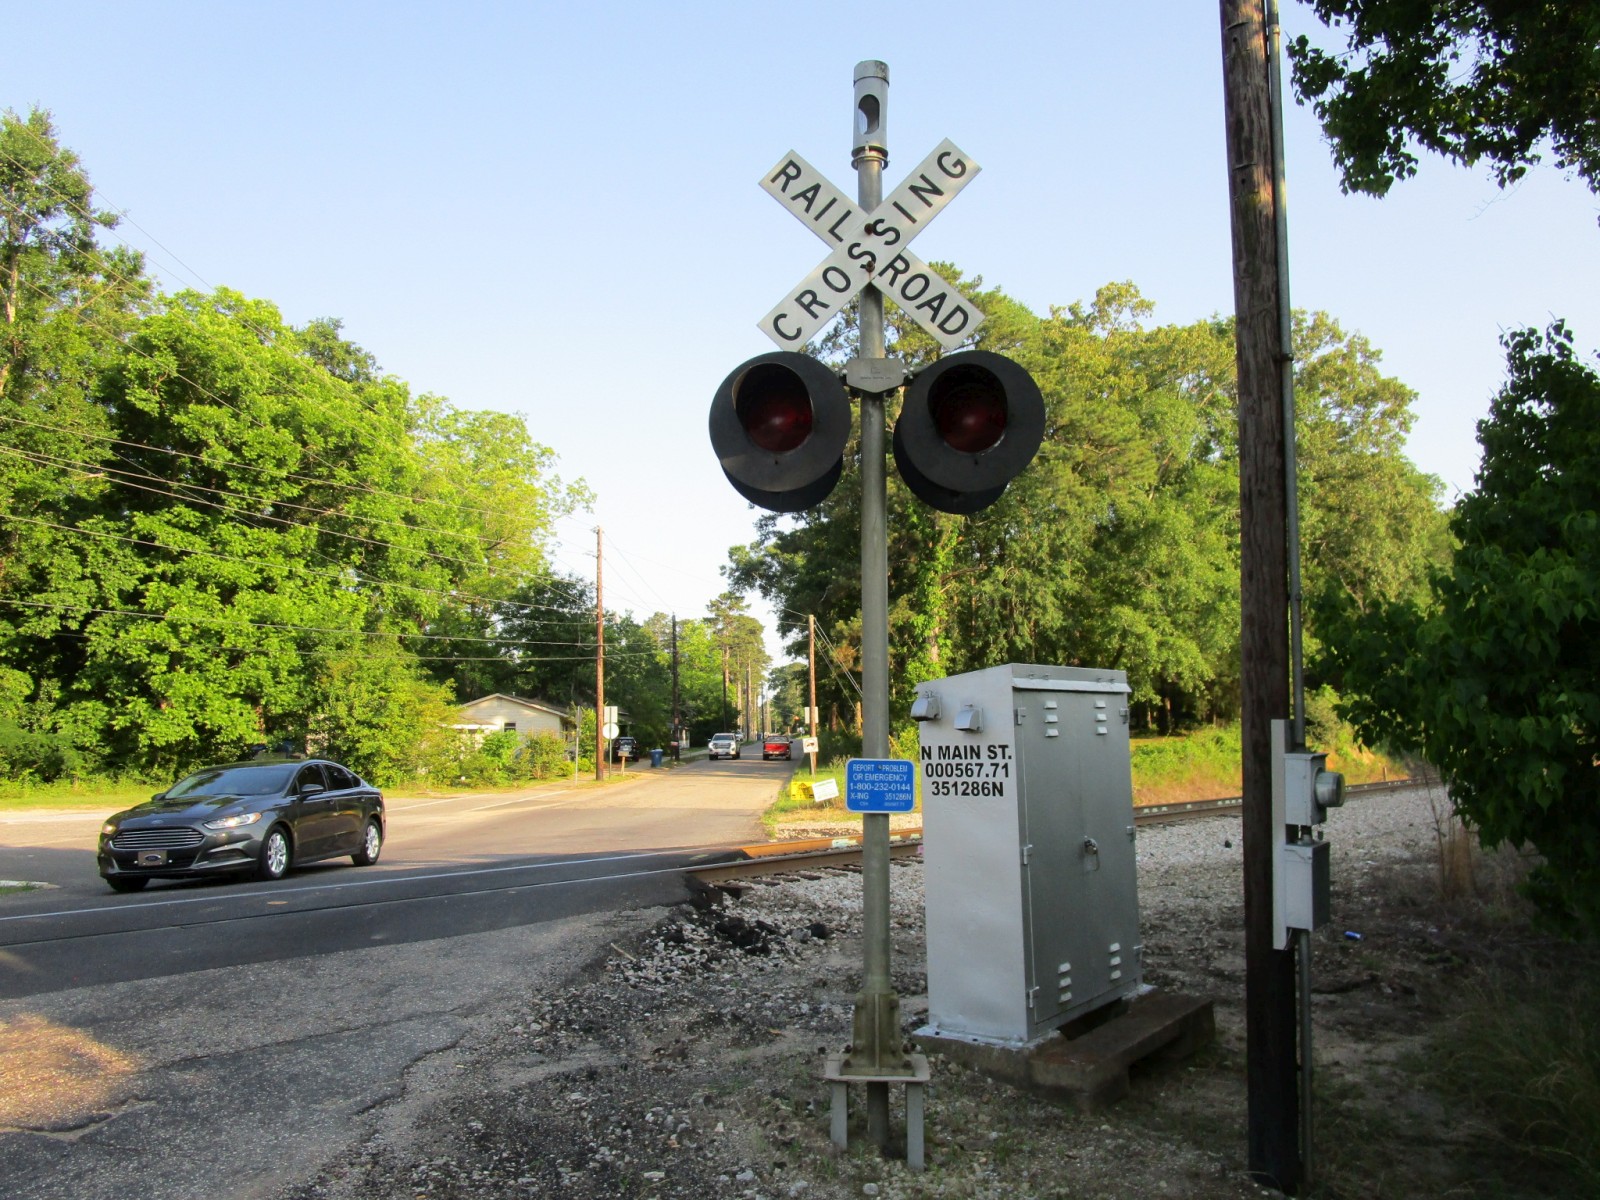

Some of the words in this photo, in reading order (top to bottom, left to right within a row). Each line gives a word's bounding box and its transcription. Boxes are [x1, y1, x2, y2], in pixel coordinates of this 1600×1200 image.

[770, 159, 853, 243] RAIL
[878, 253, 969, 336] ROAD
[772, 151, 967, 341] CROSSING
[921, 745, 932, 760] N
[938, 745, 981, 760] MAIN
[987, 744, 1012, 760] ST.
[852, 764, 875, 772] REPORT
[882, 764, 908, 773] PROBLEM
[925, 763, 1009, 778] 000567.71
[852, 773, 864, 781] OR
[864, 773, 908, 782] EMERGENCY
[849, 782, 911, 791] 1-800-232-0144
[931, 781, 1004, 797] 351286N
[850, 792, 870, 800] X-ING
[884, 792, 912, 801] 351286N
